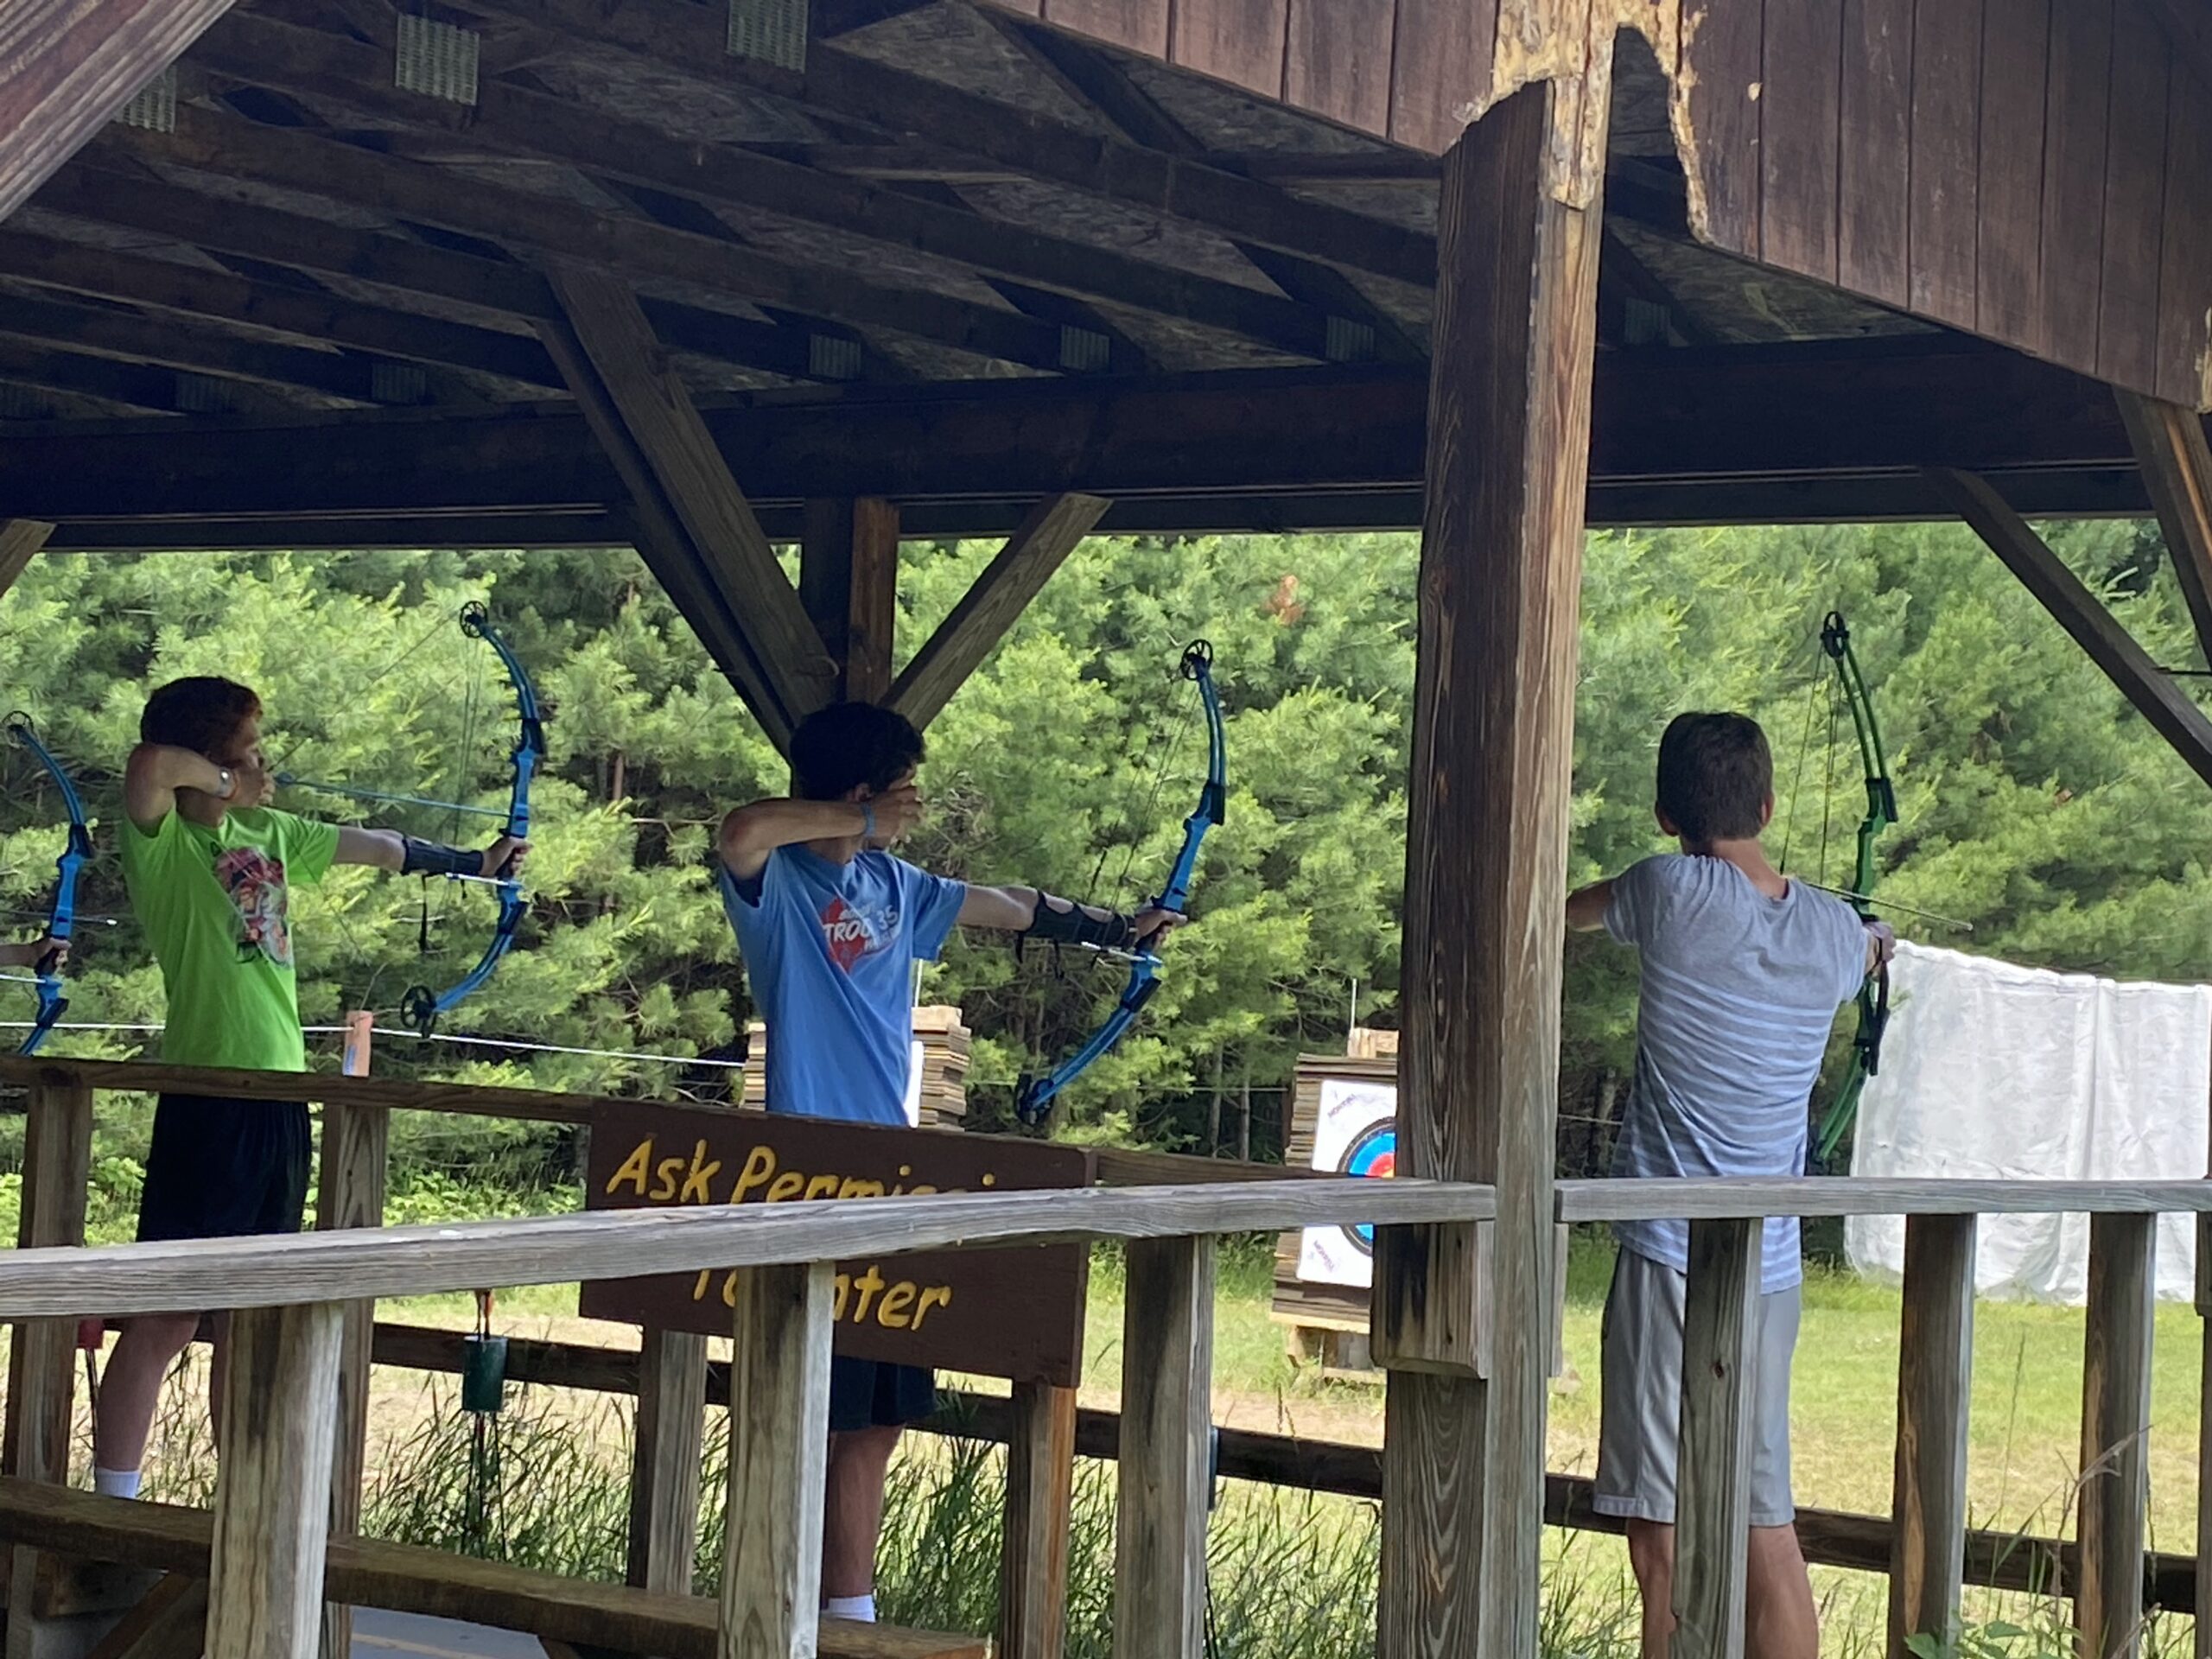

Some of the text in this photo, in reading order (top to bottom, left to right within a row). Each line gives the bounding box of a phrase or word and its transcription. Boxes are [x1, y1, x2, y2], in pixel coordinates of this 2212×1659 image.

[607, 1139, 995, 1204] Ask Permi
[834, 1265, 951, 1331] nter
